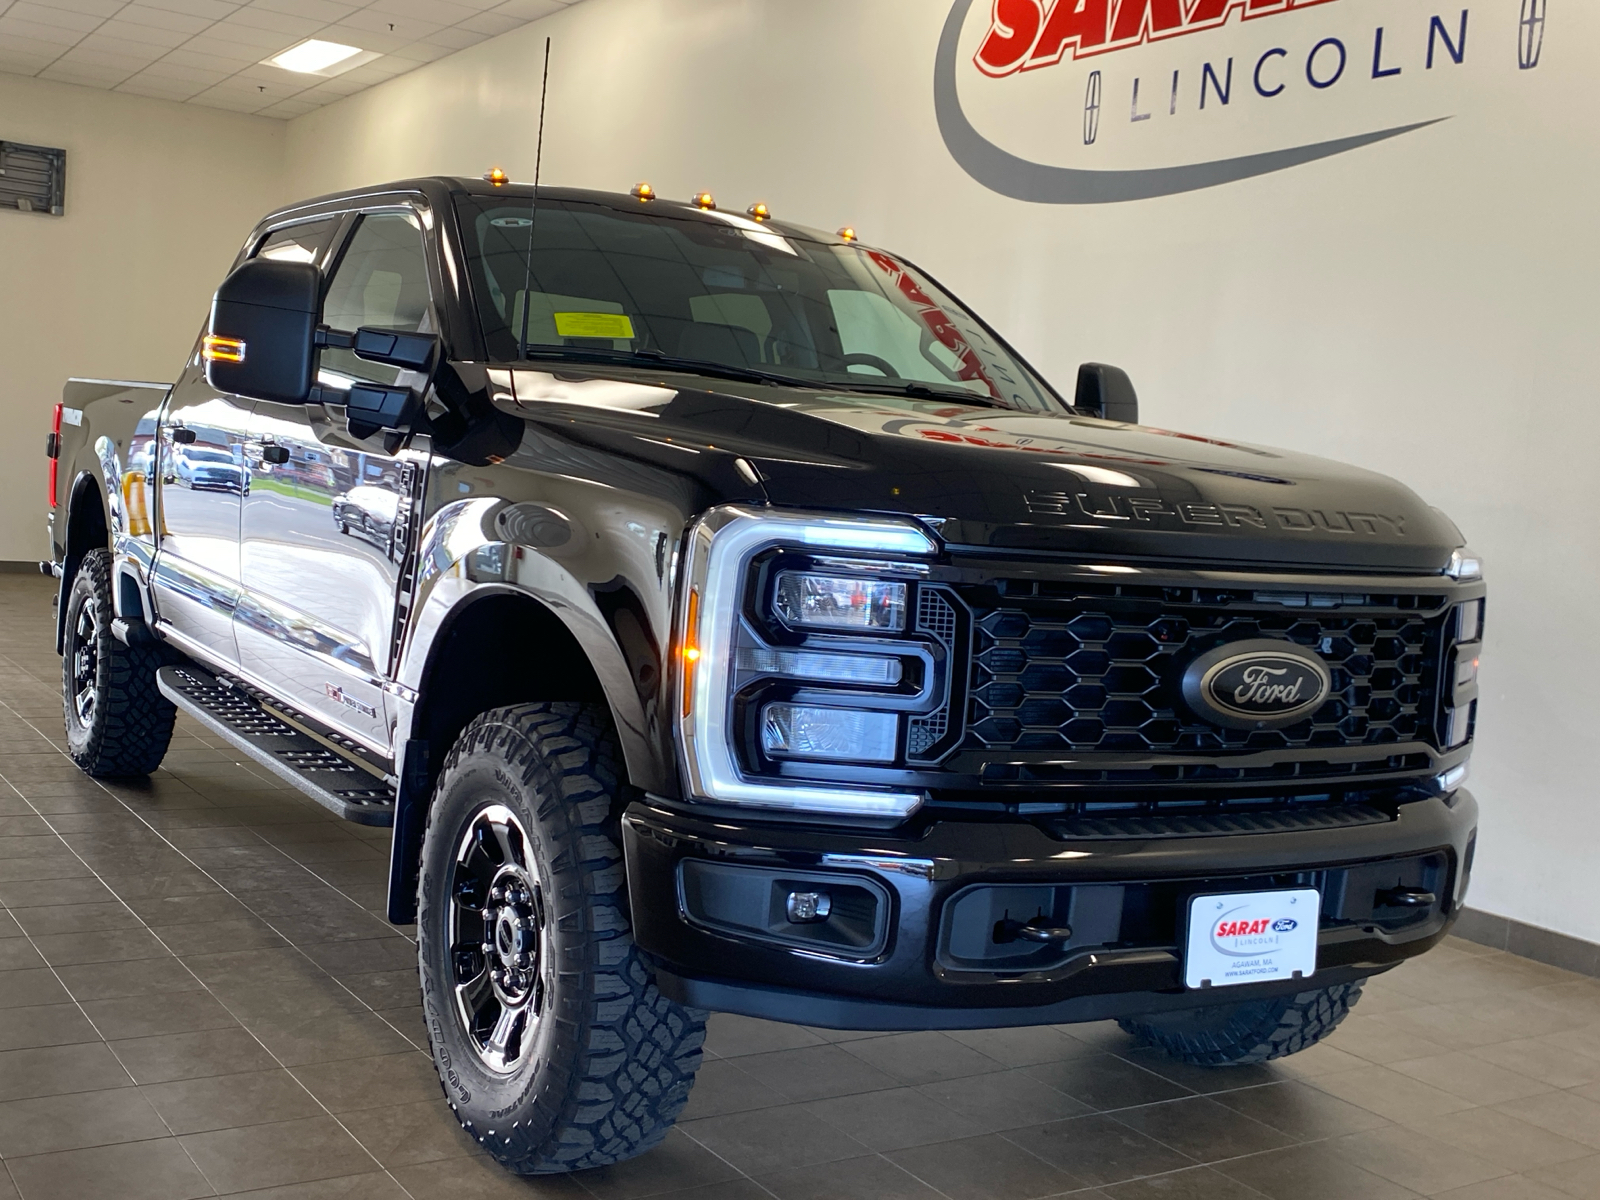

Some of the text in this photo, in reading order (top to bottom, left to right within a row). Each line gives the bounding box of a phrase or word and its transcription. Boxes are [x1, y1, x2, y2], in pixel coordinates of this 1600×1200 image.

[1129, 9, 1470, 123] LINCOLN
[1023, 490, 1407, 537] SUPER DUTY
[1234, 665, 1304, 704] Ford
[1216, 918, 1271, 938] SARAT
[1240, 937, 1274, 946] LINCOLN
[1225, 967, 1279, 978] WWW.SARATFORD.COM
[1231, 958, 1273, 969] AGAWAM, MA
